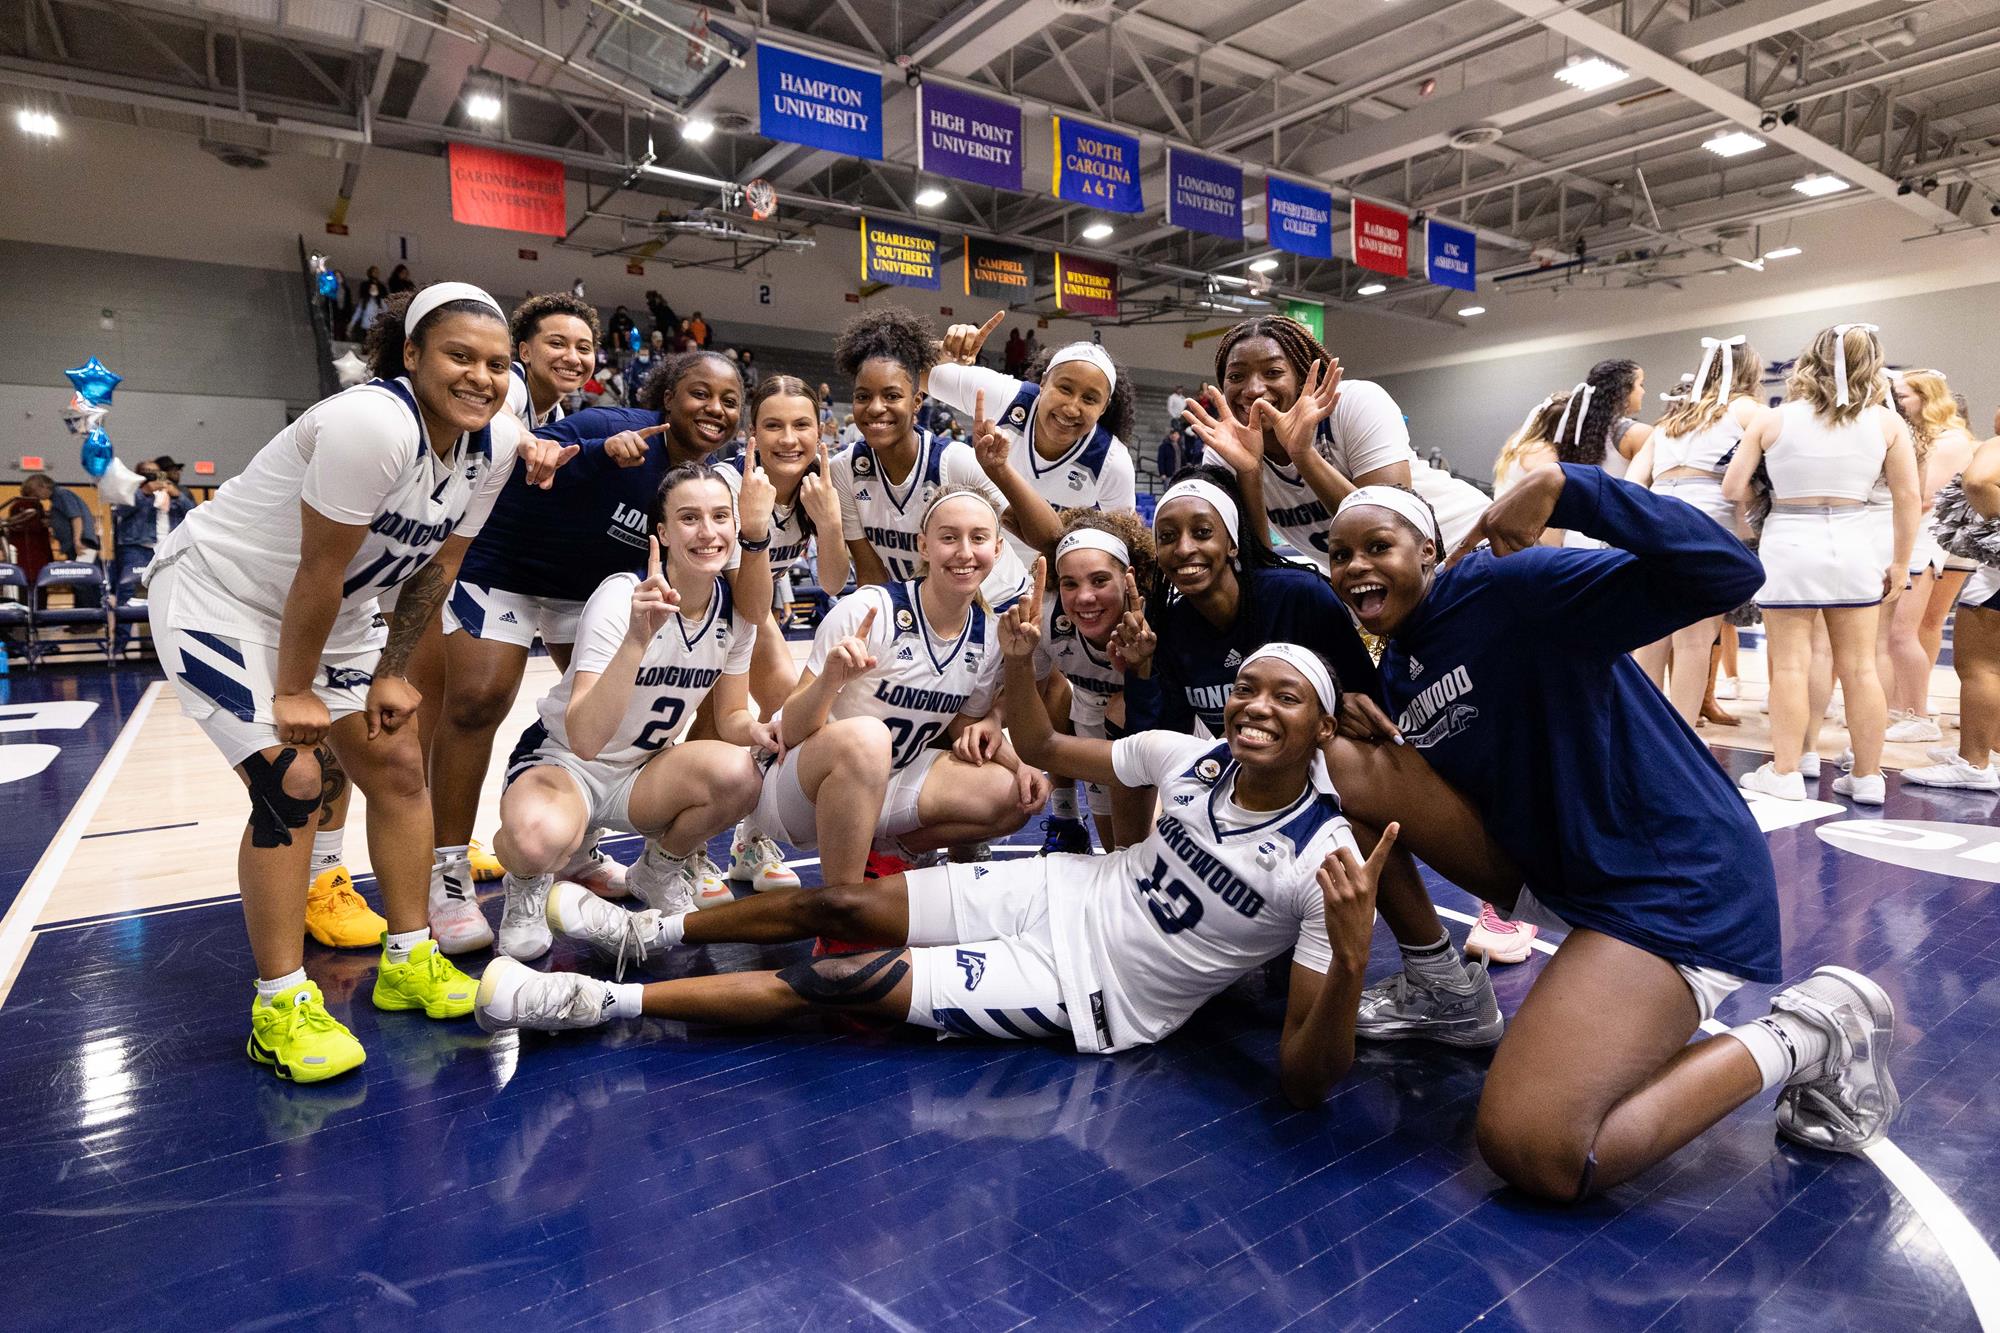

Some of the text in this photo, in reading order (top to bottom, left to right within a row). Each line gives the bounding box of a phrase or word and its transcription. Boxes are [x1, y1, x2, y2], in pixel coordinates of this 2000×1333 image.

[780, 72, 863, 108] HAMPTON
[774, 95, 868, 132] UNIVERSITY
[930, 109, 1014, 146] HIGH POINT
[932, 133, 1012, 166] UNIVERSITY
[1077, 137, 1122, 163] NORTH
[1066, 154, 1131, 184] CAROLINA
[470, 187, 550, 211] UNIVERSITY
[1082, 180, 1117, 200] A & T
[1178, 174, 1235, 201] LONGWOOD
[1177, 191, 1236, 217] UNIVERSITY
[1272, 198, 1328, 223] PRESBYTERIAN
[1282, 217, 1317, 238] COLLEGE
[1363, 222, 1400, 241] RADFORD
[870, 230, 935, 251] CHARLESTON
[1359, 236, 1404, 259] UNIVERSITY
[875, 245, 931, 264] SOUTHERN
[978, 256, 1024, 273] CAMPBELL
[873, 258, 934, 279] UNIVERSITY
[974, 269, 1028, 287] UNIVERSITY
[1066, 271, 1111, 286] WINTHROP
[760, 285, 770, 304] 2
[1064, 283, 1112, 300] UNIVERSITY
[1398, 665, 1473, 733] ONGWOOD
[632, 696, 685, 750] 2
